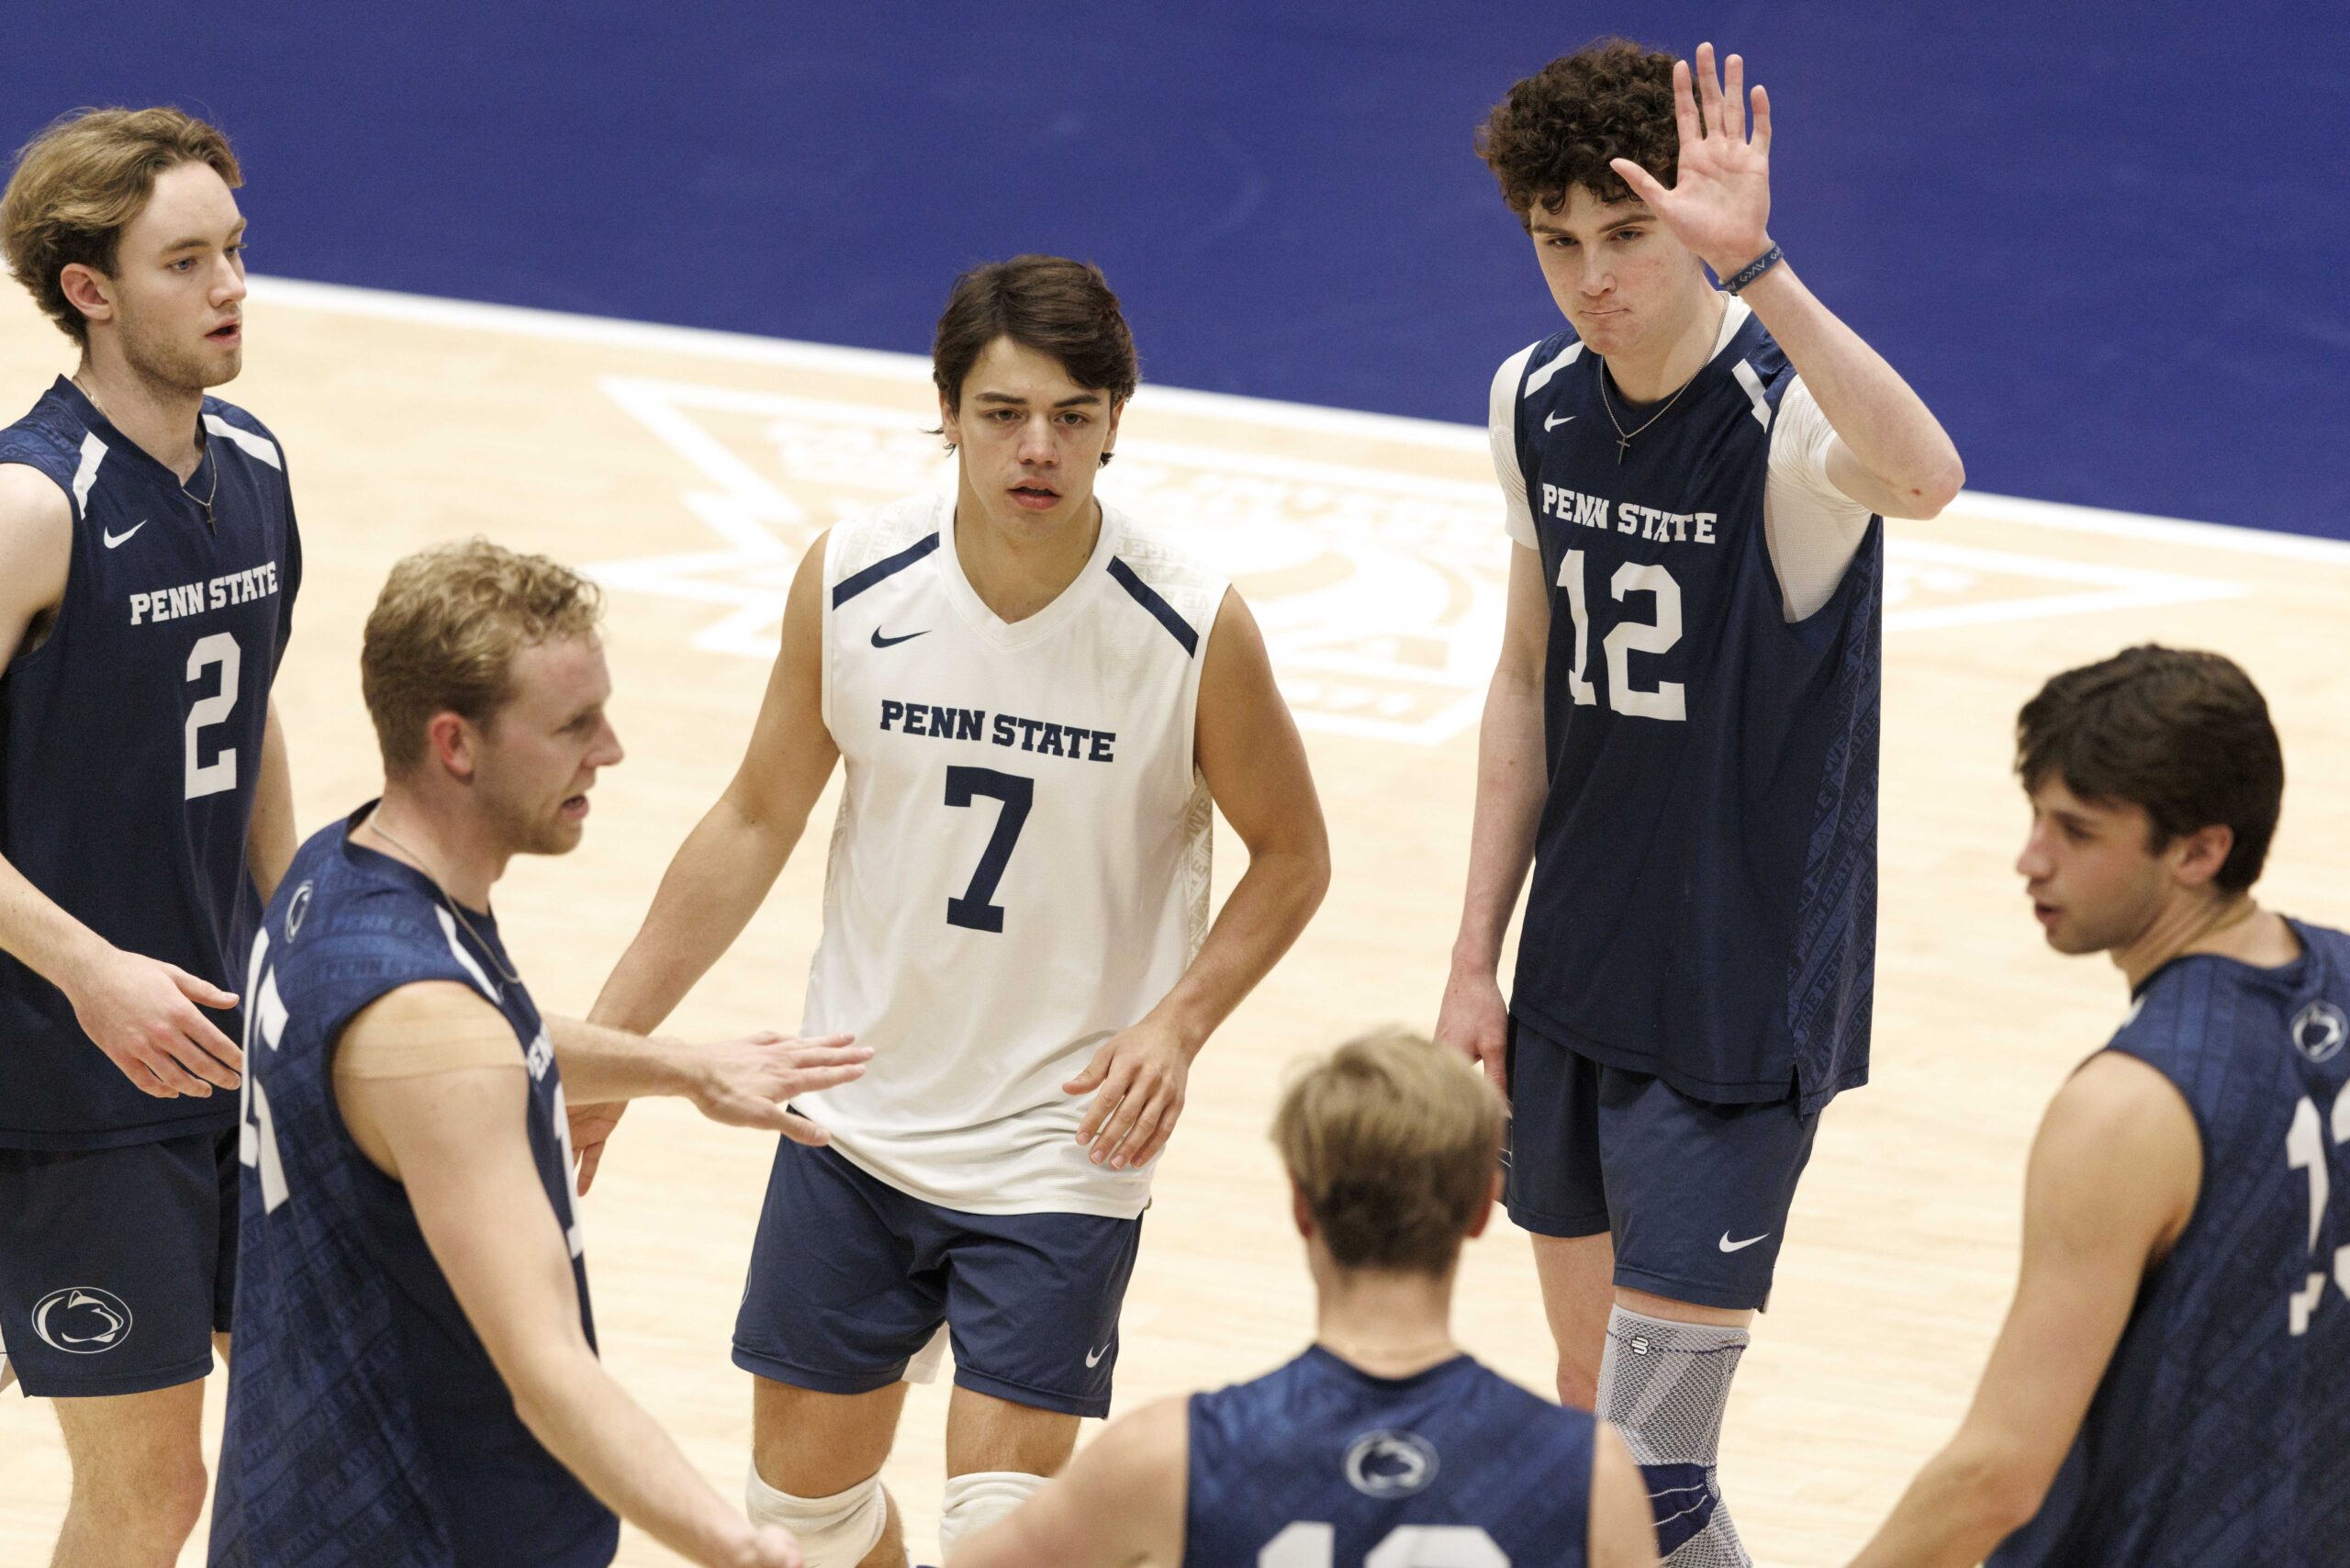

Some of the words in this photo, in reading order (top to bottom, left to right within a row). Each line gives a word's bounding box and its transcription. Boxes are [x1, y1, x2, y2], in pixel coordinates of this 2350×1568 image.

[1542, 483, 1609, 530] PENN
[1617, 502, 1718, 544] STATE
[130, 581, 205, 625] PENN
[208, 560, 278, 610] STATE
[1557, 548, 1686, 722] 12
[185, 632, 241, 801] 2
[880, 699, 986, 742] PENN
[992, 712, 1116, 763] STATE
[945, 765, 1035, 934] 7
